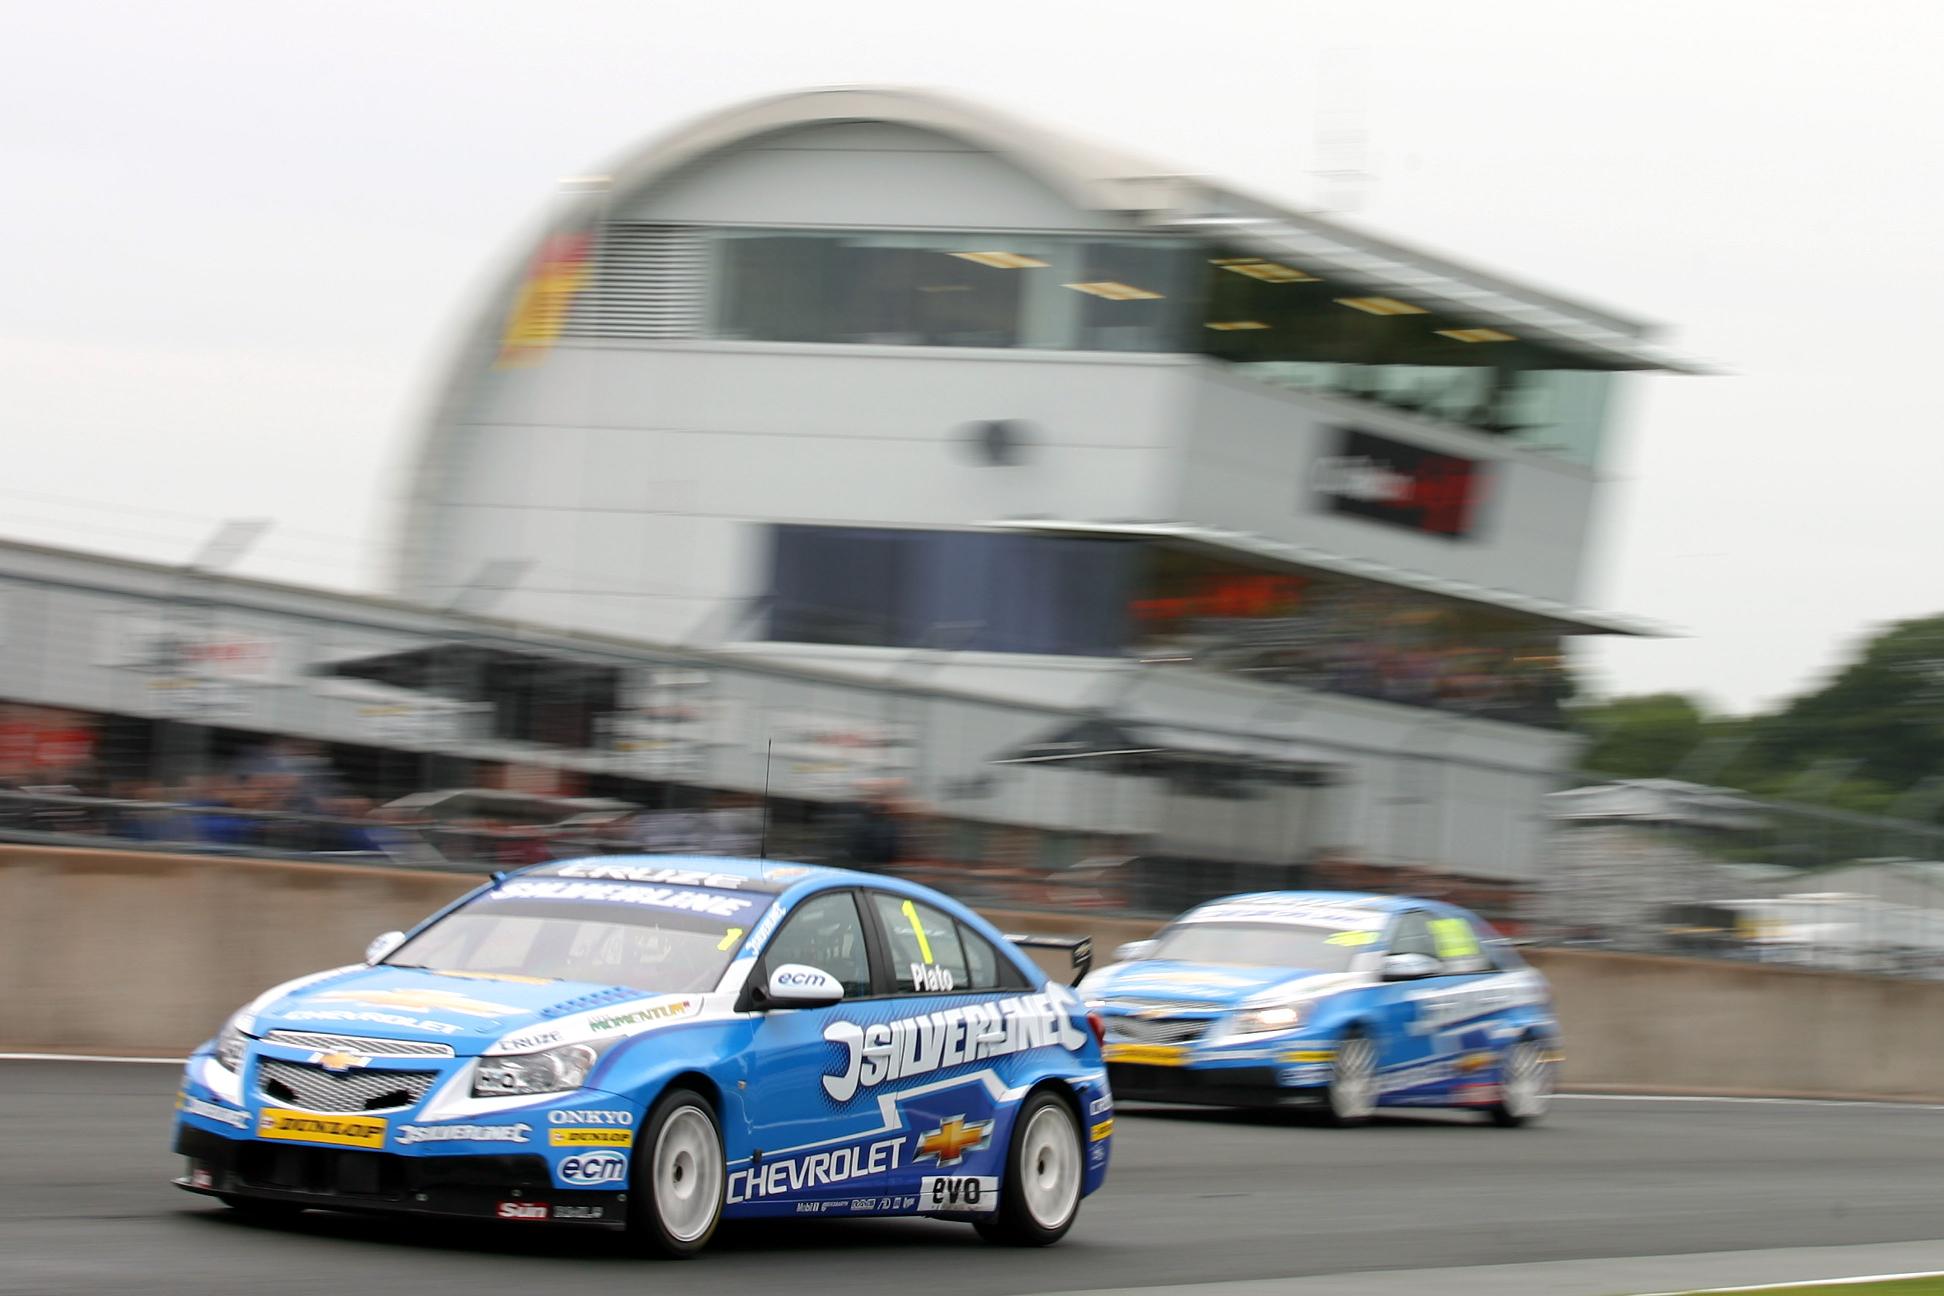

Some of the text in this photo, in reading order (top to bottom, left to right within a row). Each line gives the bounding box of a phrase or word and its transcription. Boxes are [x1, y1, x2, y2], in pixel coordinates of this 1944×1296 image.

[716, 927, 744, 952] 1
[902, 900, 934, 964] 1
[777, 972, 827, 987] ecm
[910, 963, 954, 992] Plato
[282, 1010, 464, 1035] CHEVROLET
[278, 1117, 385, 1139] DUNLOP
[548, 1110, 633, 1126] ONKYO
[568, 1132, 630, 1143] DUNLOP
[562, 1157, 625, 1180] ecm
[726, 1136, 907, 1205] CHEVROLET
[932, 1177, 981, 1206] evo
